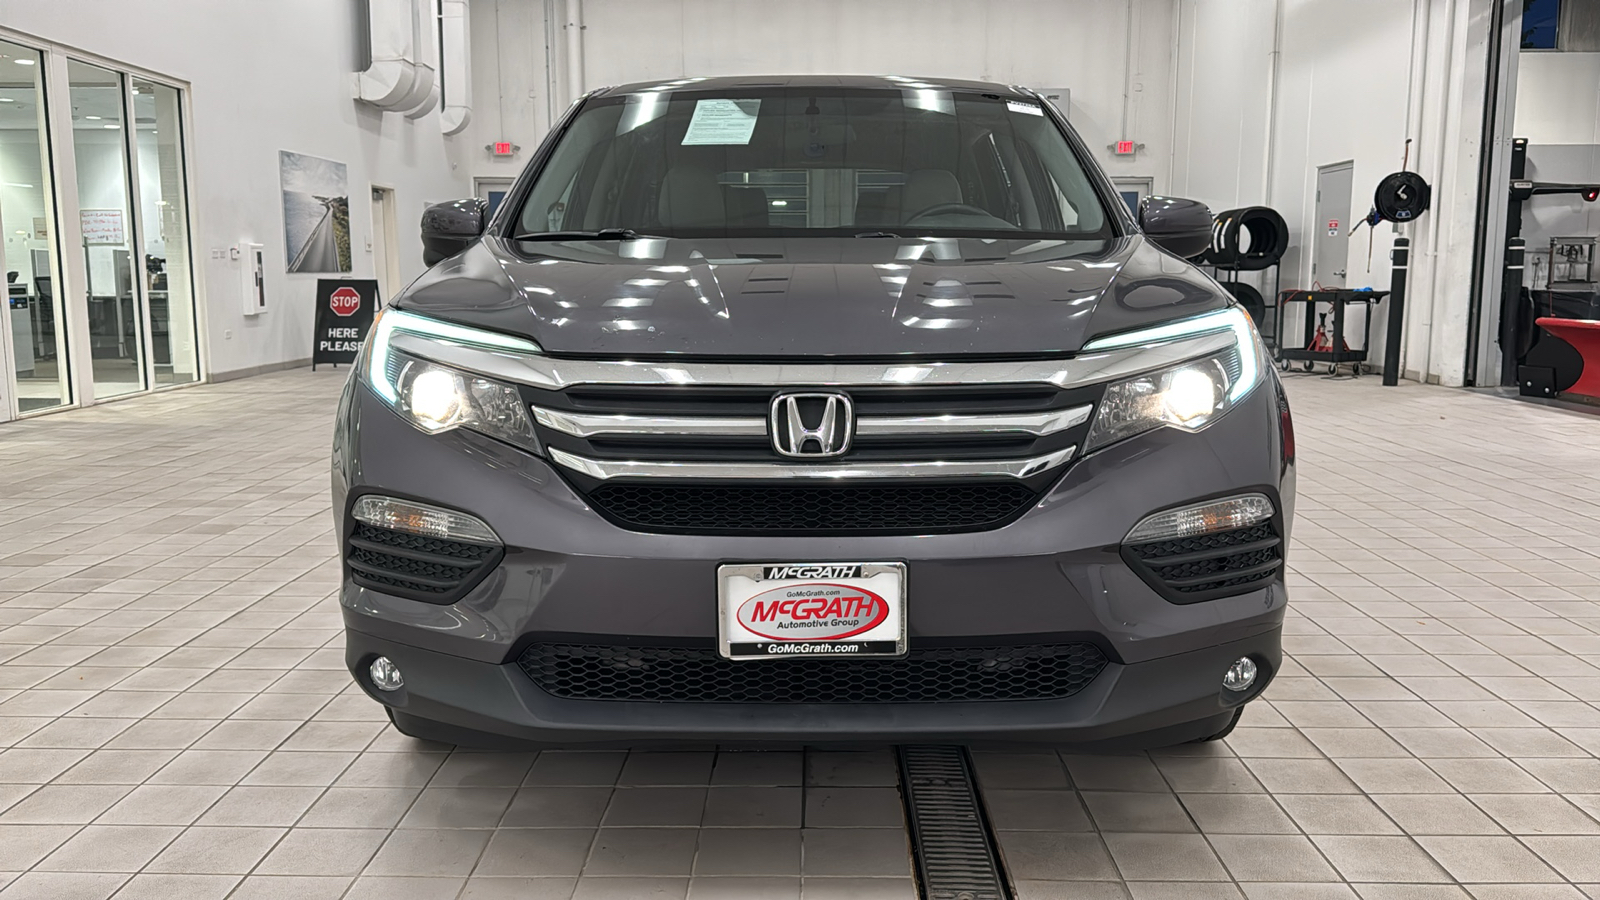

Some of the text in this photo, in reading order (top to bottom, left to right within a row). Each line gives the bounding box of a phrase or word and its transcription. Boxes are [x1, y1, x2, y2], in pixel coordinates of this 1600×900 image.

[332, 296, 358, 307] STOP
[328, 328, 359, 338] HERE
[786, 590, 841, 598] GoMcGrath.com
[777, 619, 859, 629] Automotive Group
[768, 643, 858, 654] GoMcGrath.com
